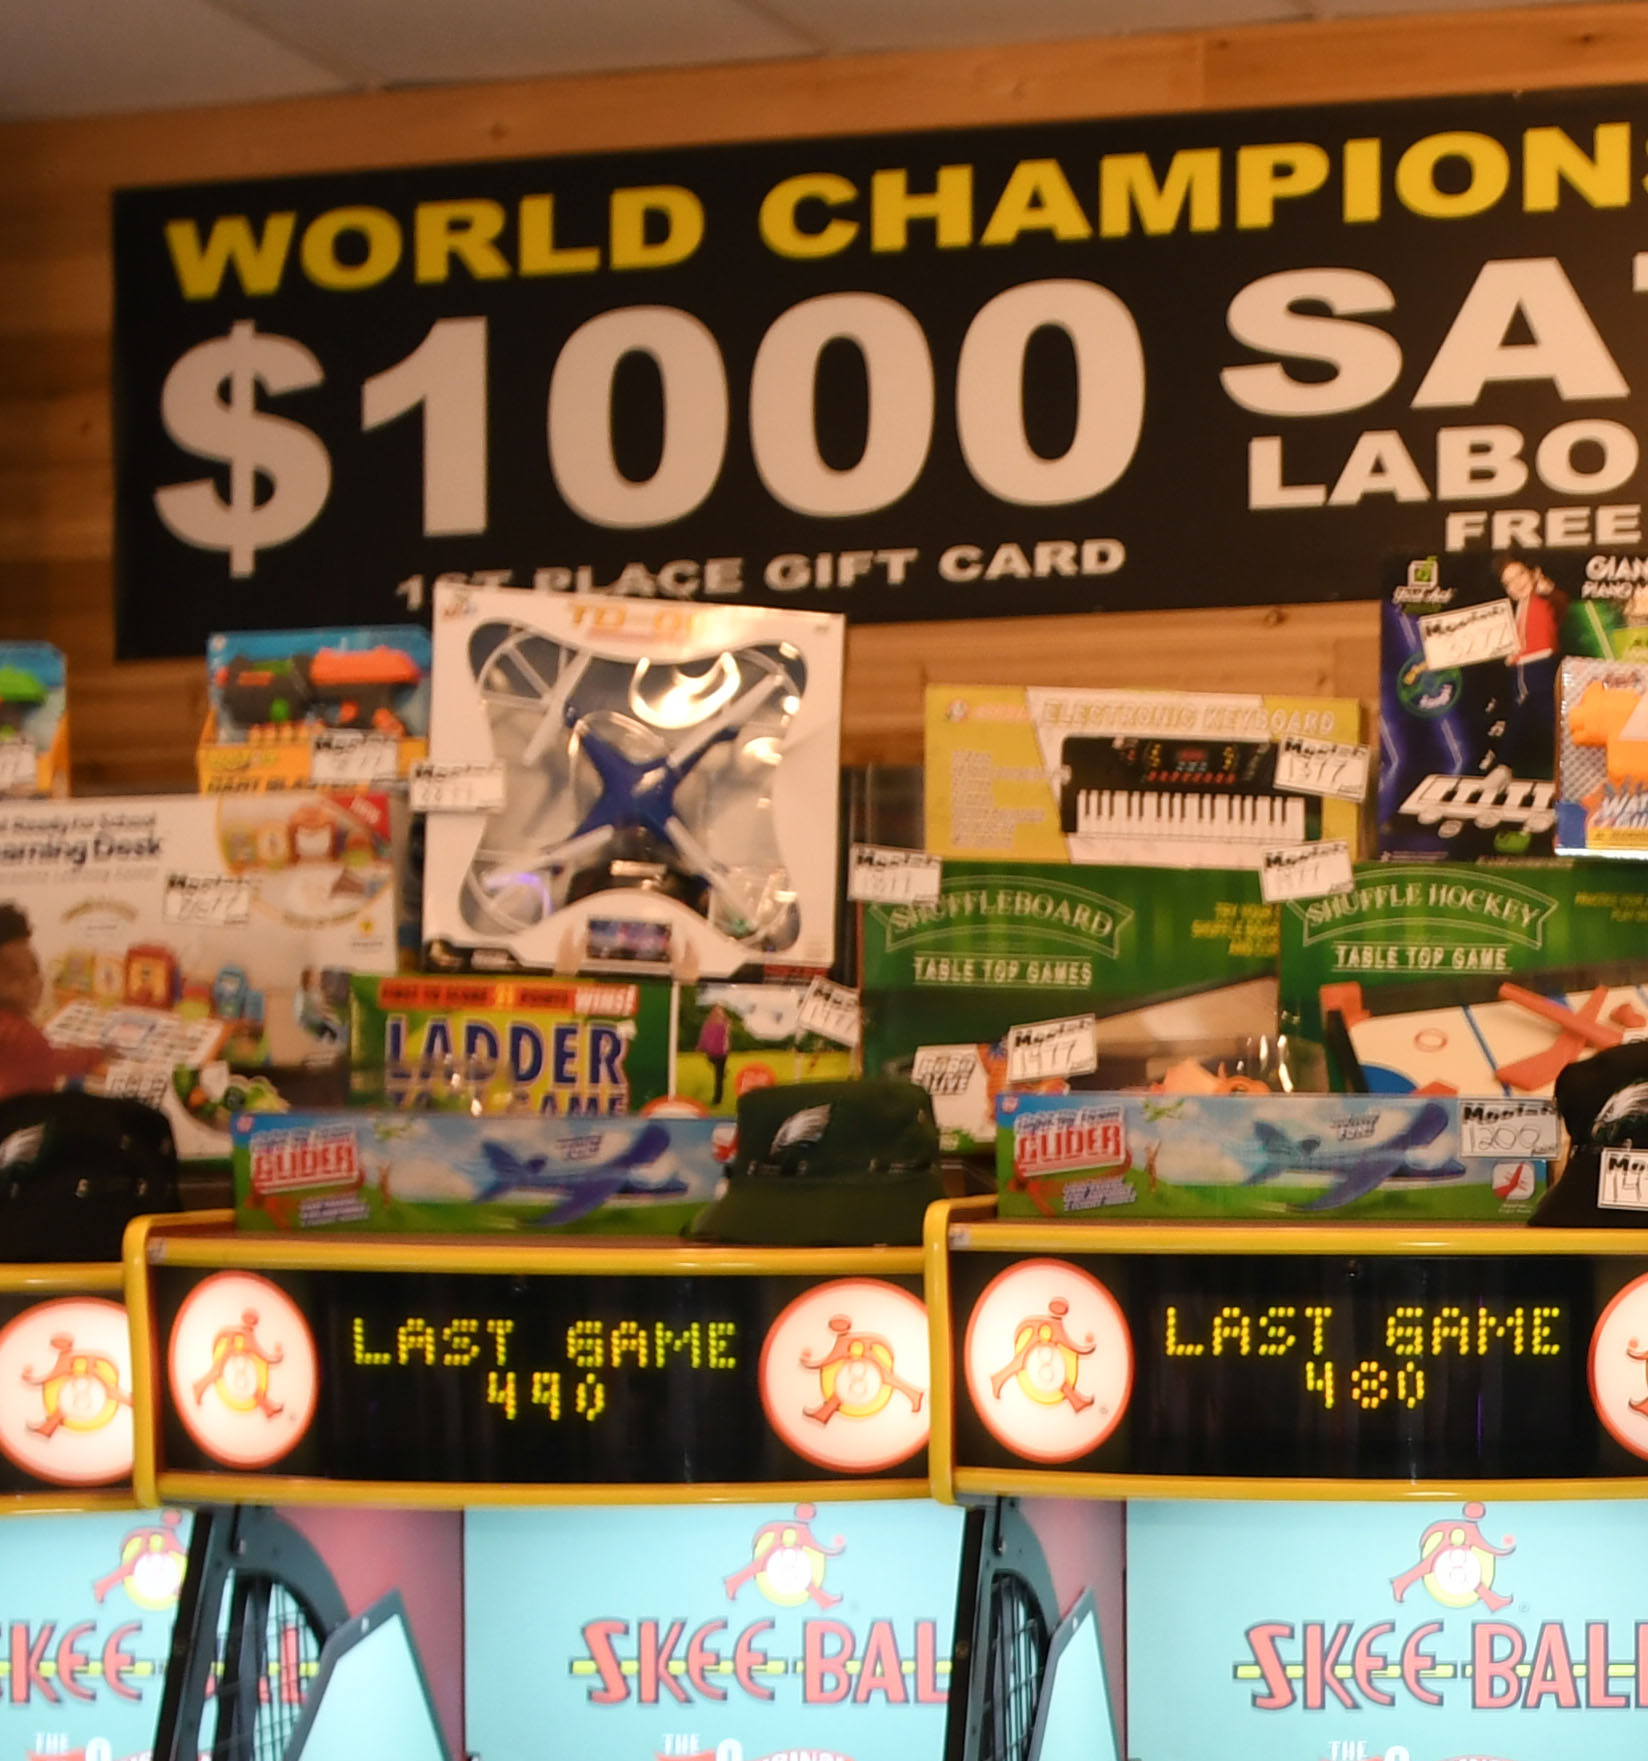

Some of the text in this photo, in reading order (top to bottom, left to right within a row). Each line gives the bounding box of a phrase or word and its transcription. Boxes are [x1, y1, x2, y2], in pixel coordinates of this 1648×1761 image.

[165, 187, 706, 300] WORLD
[152, 279, 1148, 579] $1000
[1446, 507, 1633, 550] FREE
[765, 546, 911, 594] GIFT
[940, 537, 1128, 582] CARD
[1203, 705, 1336, 734] KEYBOARD
[889, 889, 1113, 938] SHUFFLEBOARD
[1304, 881, 1423, 928] SHUFFLE
[1428, 882, 1540, 930] HOCKEY
[914, 956, 1093, 987] TABLE TOP GAMES
[1335, 945, 1508, 970] TABLE TOP GAME
[386, 1012, 630, 1086] LADDER
[254, 1138, 356, 1182] GLIDER
[1017, 1123, 1124, 1167] GLIDER
[352, 1317, 738, 1369] LAST GAME
[1165, 1306, 1562, 1358] LAST GAME
[486, 1371, 605, 1422] 490
[1304, 1360, 1425, 1410] 480
[663, 1734, 700, 1755] THE
[1329, 1741, 1367, 1761] THE
